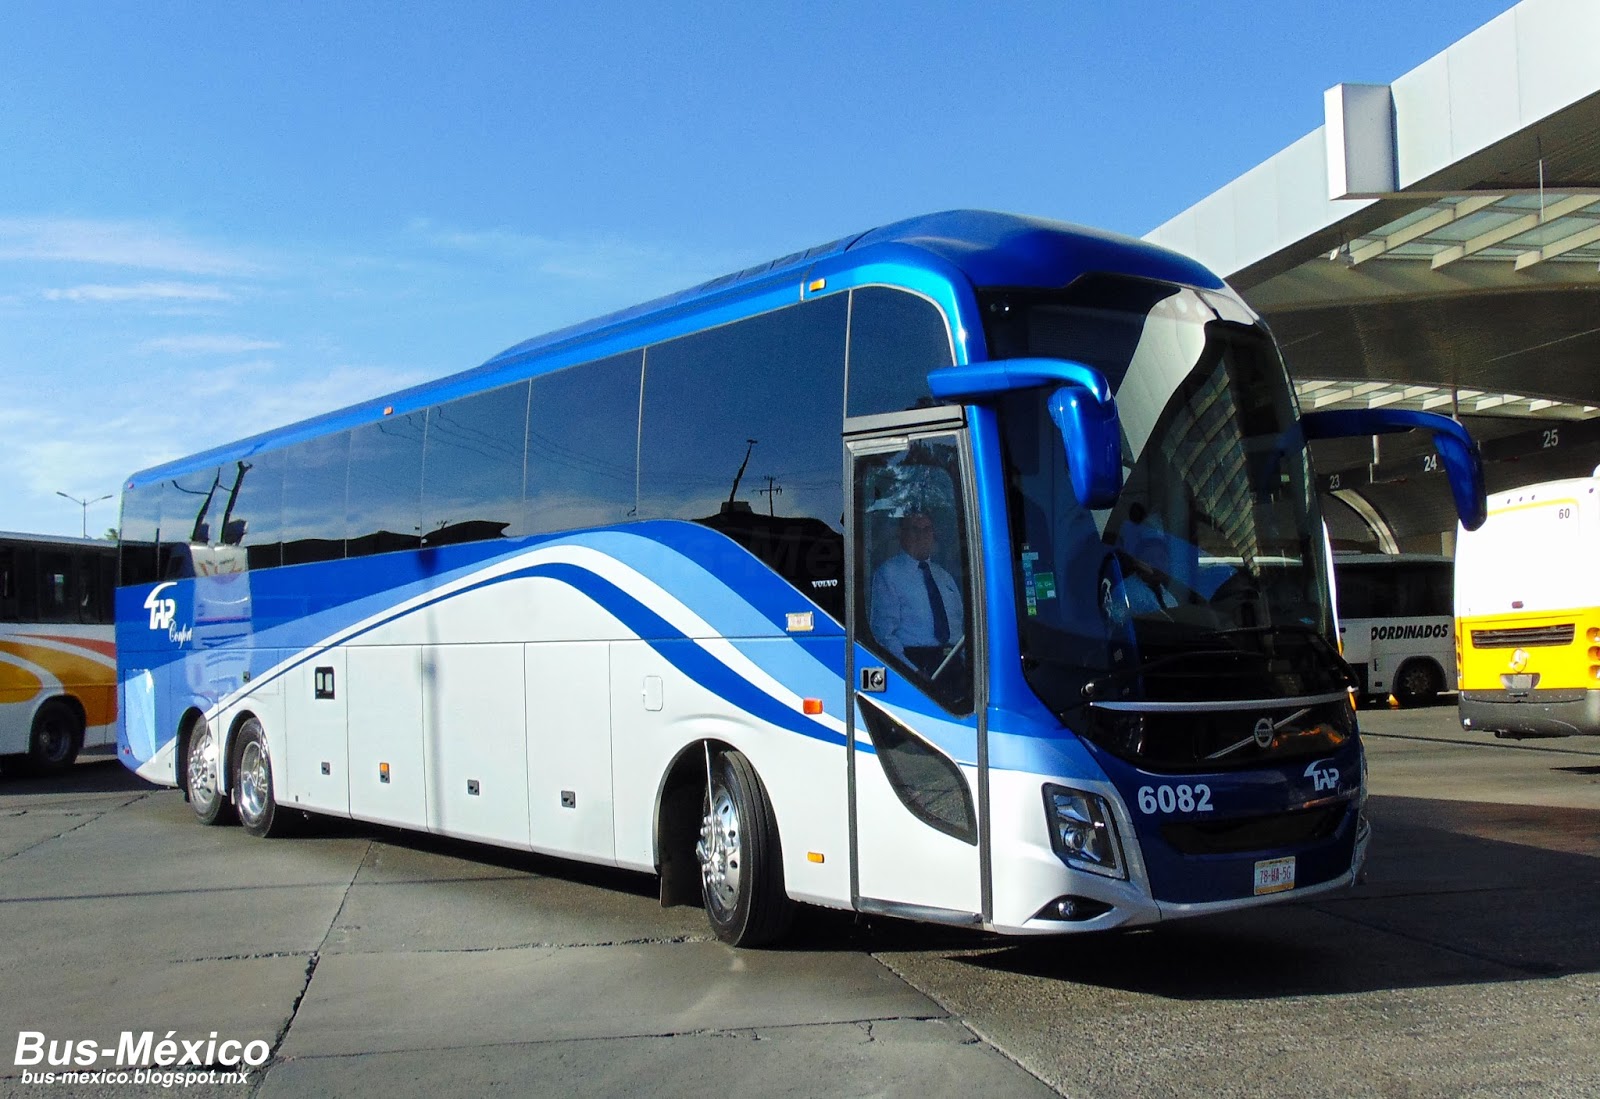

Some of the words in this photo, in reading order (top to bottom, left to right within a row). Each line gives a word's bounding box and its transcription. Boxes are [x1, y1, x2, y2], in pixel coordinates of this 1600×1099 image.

[1543, 429, 1559, 448] 25
[1424, 454, 1438, 472] 24
[1329, 474, 1341, 489] 23
[1558, 508, 1571, 519] 60
[811, 579, 838, 588] VOLVO
[144, 582, 178, 630] TAP
[1303, 757, 1340, 791] TAP
[1137, 784, 1214, 814] 6082
